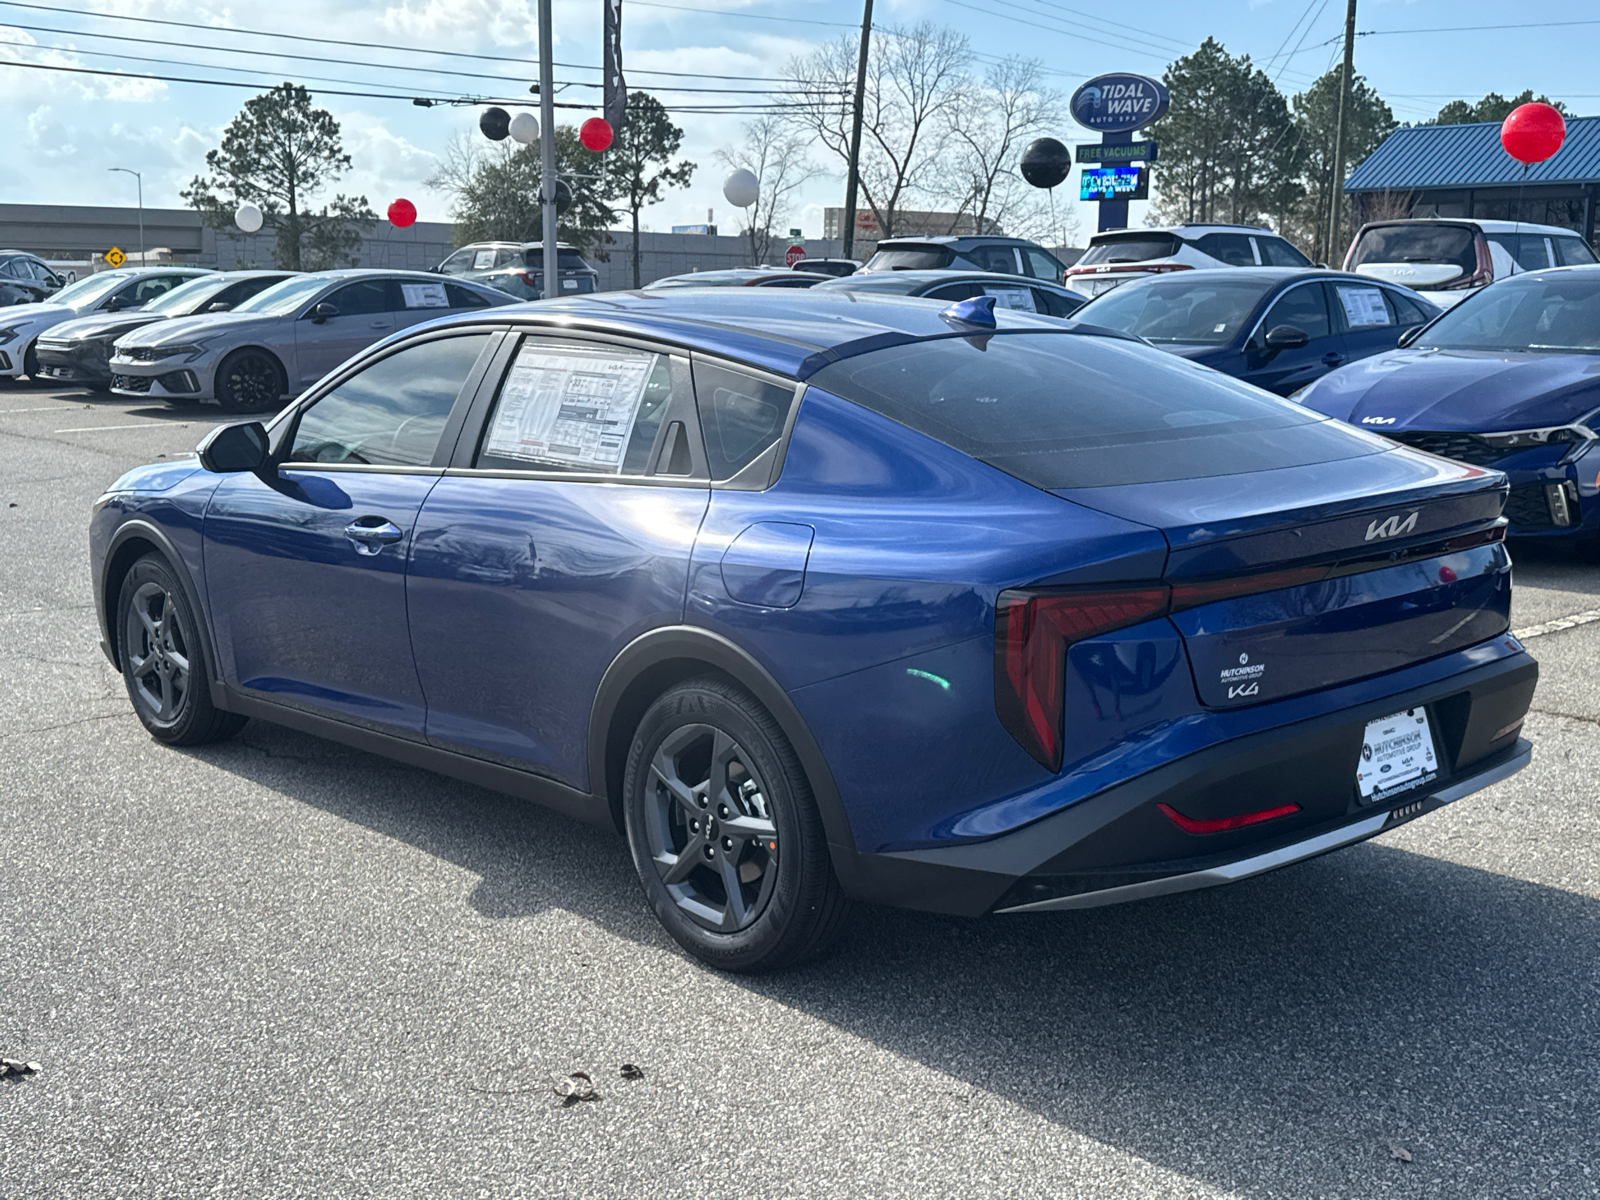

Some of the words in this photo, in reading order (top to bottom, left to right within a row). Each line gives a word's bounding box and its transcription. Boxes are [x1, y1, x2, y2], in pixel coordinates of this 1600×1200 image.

[1102, 83, 1144, 99] TIDAL
[1107, 98, 1153, 114] WAVE
[1078, 148, 1102, 159] FREE
[1103, 145, 1146, 158] VACUUMS
[786, 253, 806, 264] STOP
[1393, 269, 1415, 277] KIA
[1362, 416, 1396, 425] KIA
[1364, 512, 1419, 541] KIA
[1220, 663, 1265, 678] HUTCHINSON
[1221, 674, 1248, 683] AUTOMOTIVE
[1228, 681, 1259, 699] K4
[1374, 730, 1422, 755] HUTCHINSON
[1377, 747, 1406, 763] AUTOMOTIVE
[1406, 742, 1422, 753] GROUP
